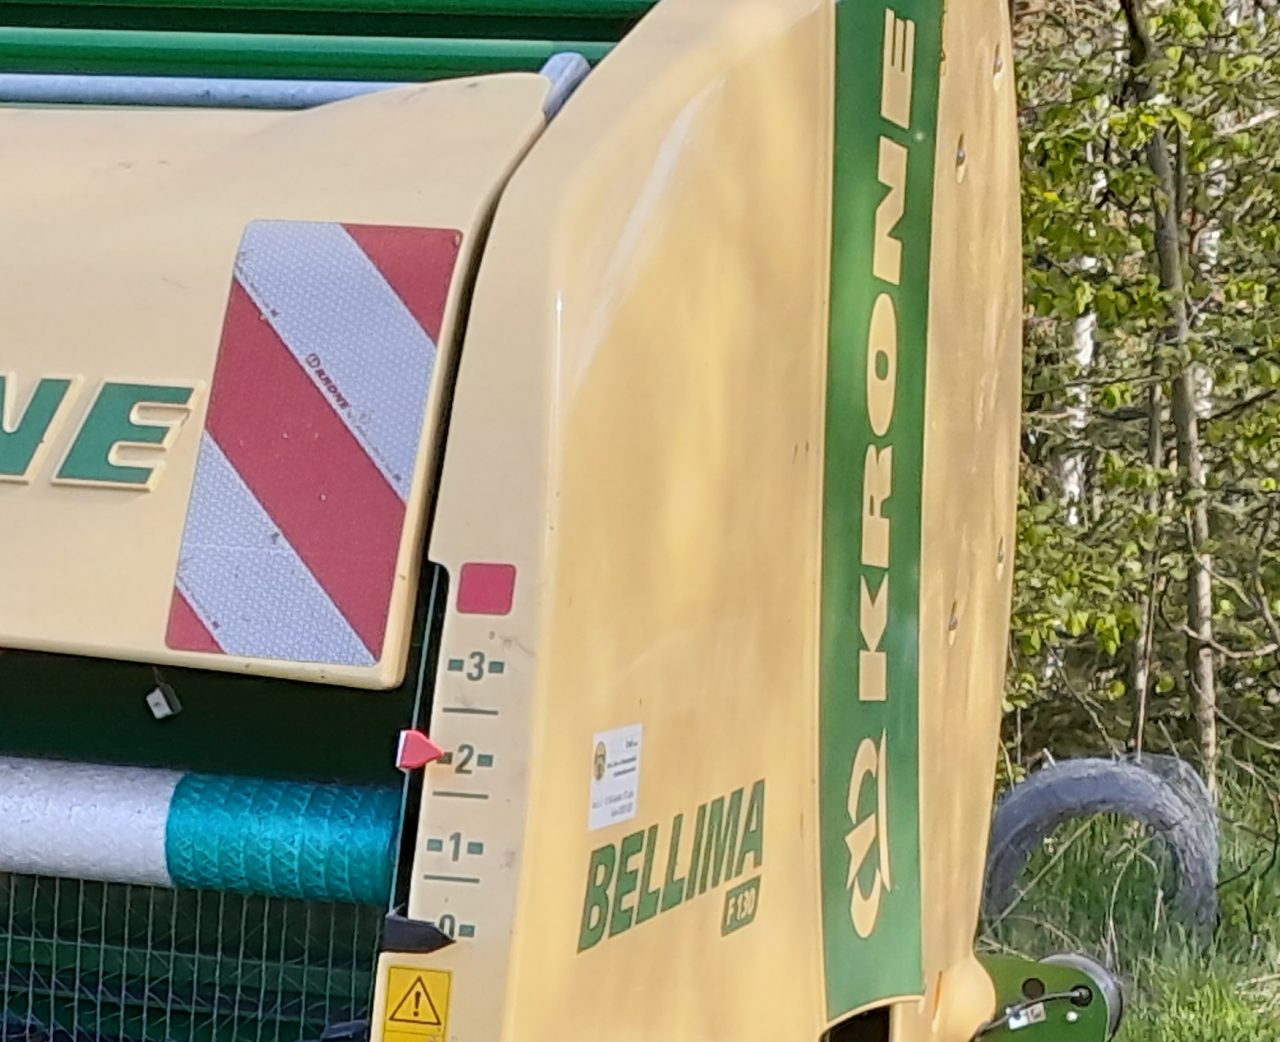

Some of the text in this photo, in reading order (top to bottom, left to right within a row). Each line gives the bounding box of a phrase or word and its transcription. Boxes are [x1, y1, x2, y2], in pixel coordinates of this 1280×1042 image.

[858, 6, 915, 701] KRONE
[466, 651, 486, 682] 3
[455, 743, 474, 774] 2
[449, 832, 462, 861] 1
[577, 778, 766, 954] BELLIMA
